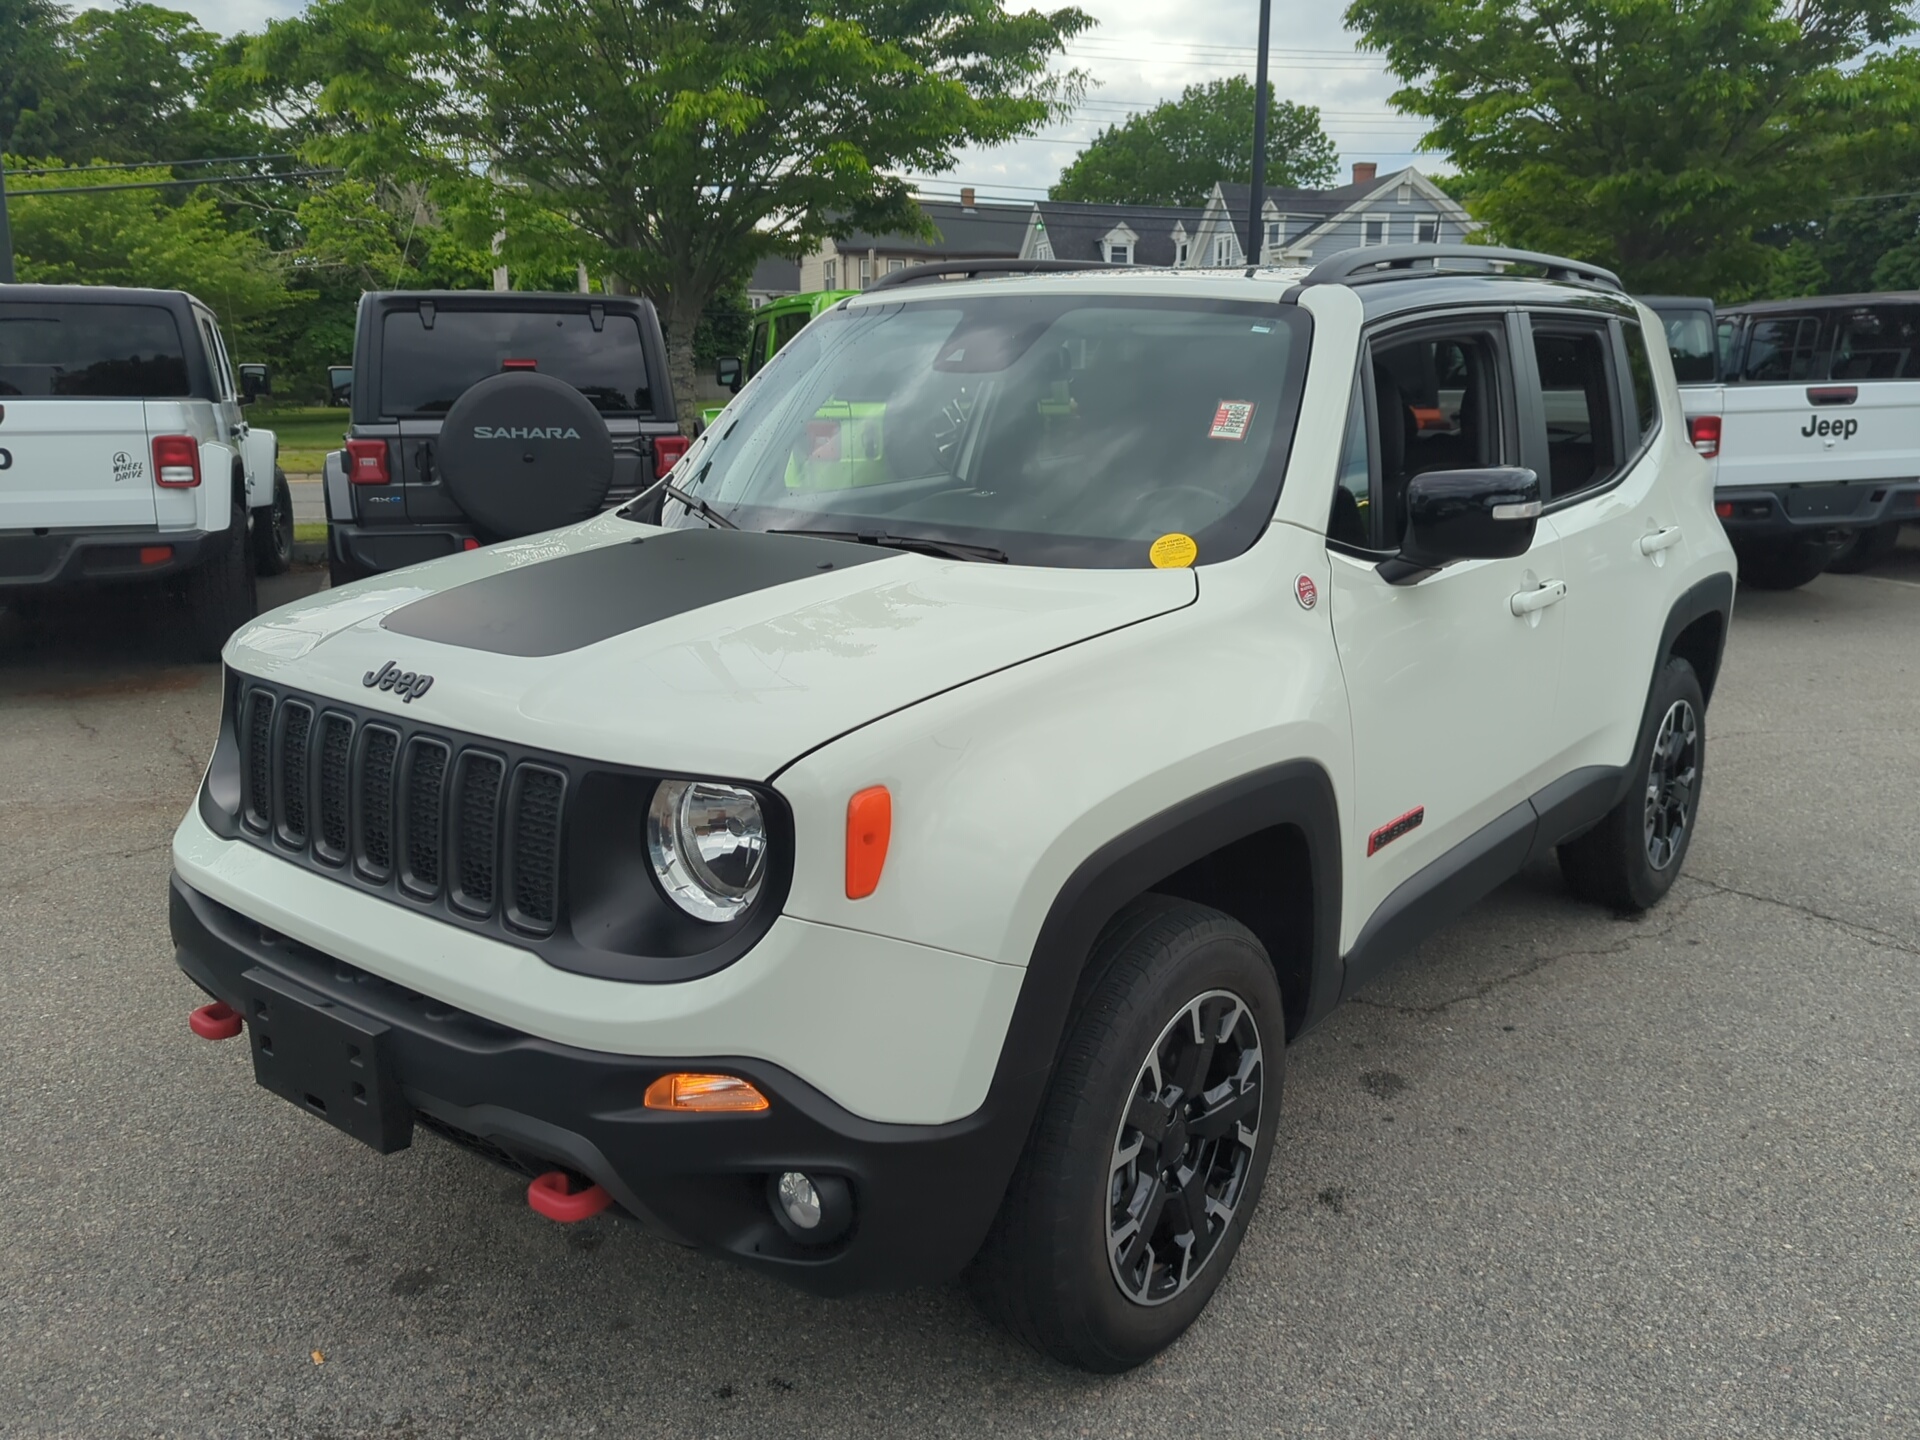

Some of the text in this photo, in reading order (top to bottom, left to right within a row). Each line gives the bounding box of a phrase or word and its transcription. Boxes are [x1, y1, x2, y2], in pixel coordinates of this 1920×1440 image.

[473, 426, 581, 439] SAHARA
[1801, 414, 1858, 440] Jeep
[113, 461, 143, 474] WHEEL
[115, 469, 143, 482] DRIVE
[362, 660, 434, 704] Jeep
